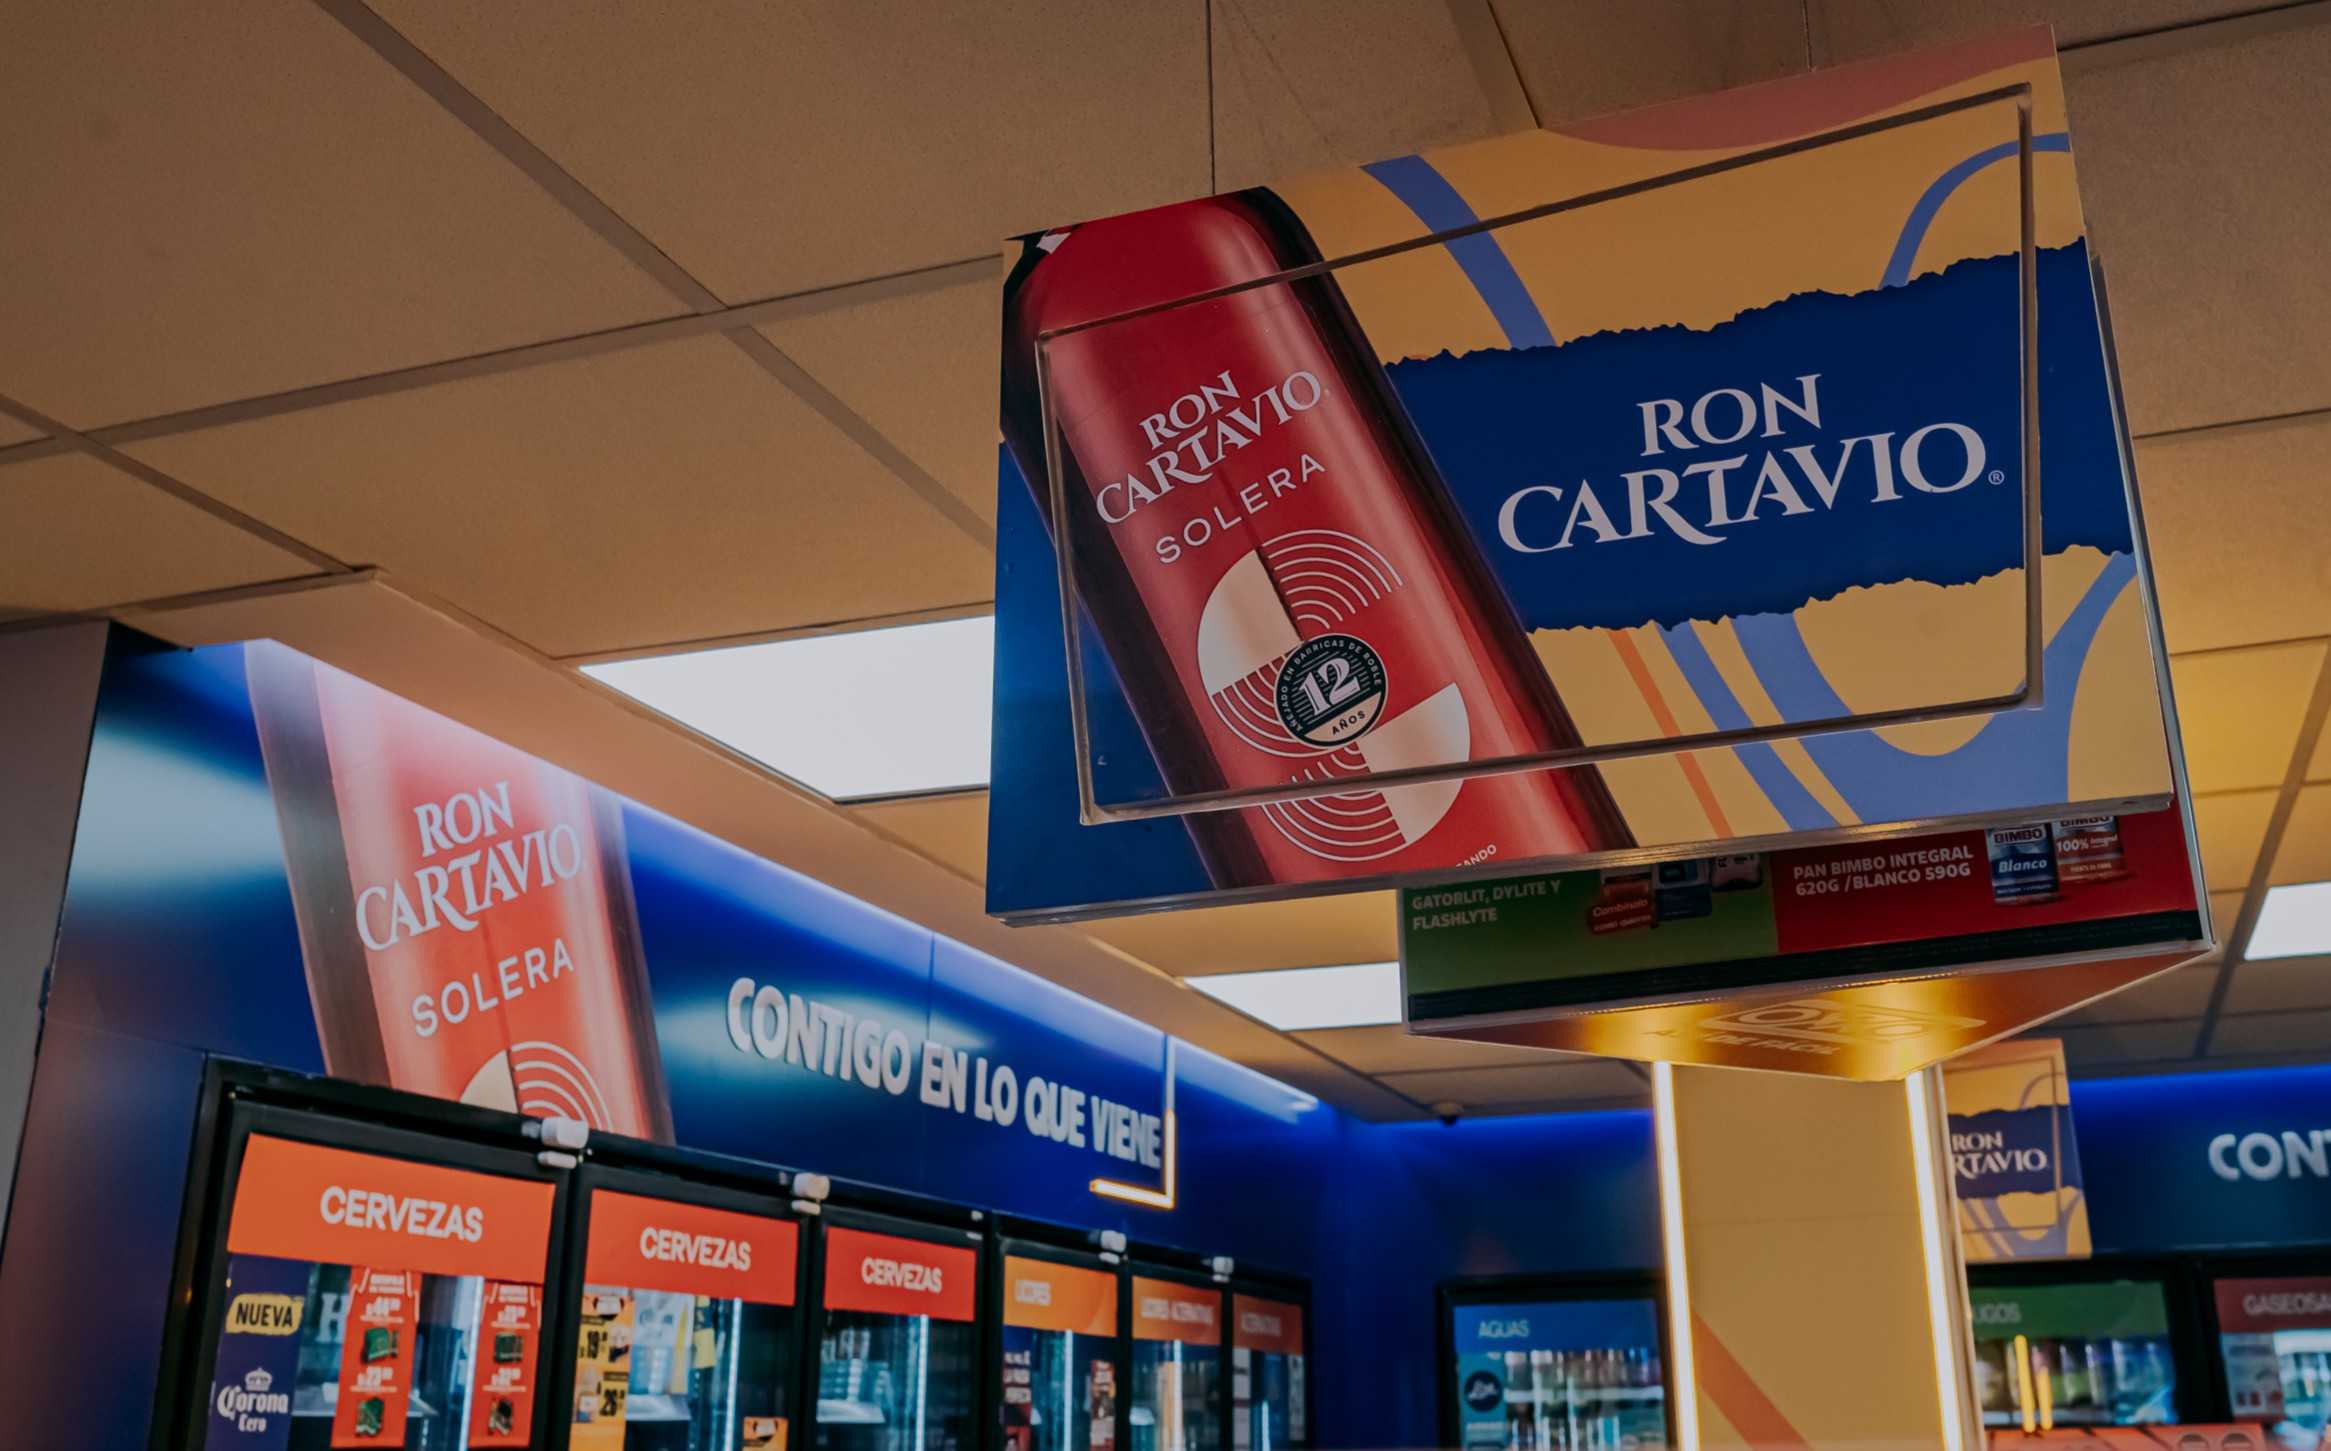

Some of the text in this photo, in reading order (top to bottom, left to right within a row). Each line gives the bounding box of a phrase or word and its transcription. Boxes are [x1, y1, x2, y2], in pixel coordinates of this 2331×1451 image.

[1139, 371, 1240, 449] RON
[1636, 374, 1822, 456] RON
[1096, 371, 1322, 523] CARTAVIO
[1156, 452, 1325, 564] SOLERA
[1348, 642, 1362, 654] DE
[1362, 652, 1382, 685] ROBLE
[1299, 658, 1361, 716] 12
[1332, 711, 1366, 735] AÑOS
[414, 781, 515, 857] RON
[1994, 828, 2043, 844] BIMBO
[1794, 845, 1974, 880] PAN BIMBO INTEGRAL
[1796, 879, 1839, 896] 620G
[1925, 863, 1971, 880] 590G
[1999, 859, 2047, 874] Blanco
[356, 823, 581, 950] CARTAVIO
[1493, 881, 1546, 900] DYLITE
[1551, 879, 1561, 893] Y
[1413, 907, 1498, 930] FLASHLYTE
[411, 938, 574, 1037] SOLERA
[727, 977, 1160, 1168] CONTIGO EN LO QUE VIENE
[1952, 1131, 2003, 1152] RON
[1953, 1148, 2047, 1180] RTAVIO
[320, 1186, 484, 1242] CERVEZAS
[639, 1226, 752, 1272] CERVEZAS
[861, 1257, 943, 1294] CERVEZAS
[236, 1302, 293, 1327] NUEVA
[1478, 1319, 1529, 1339] AGUAS
[217, 1384, 289, 1421] Corona
